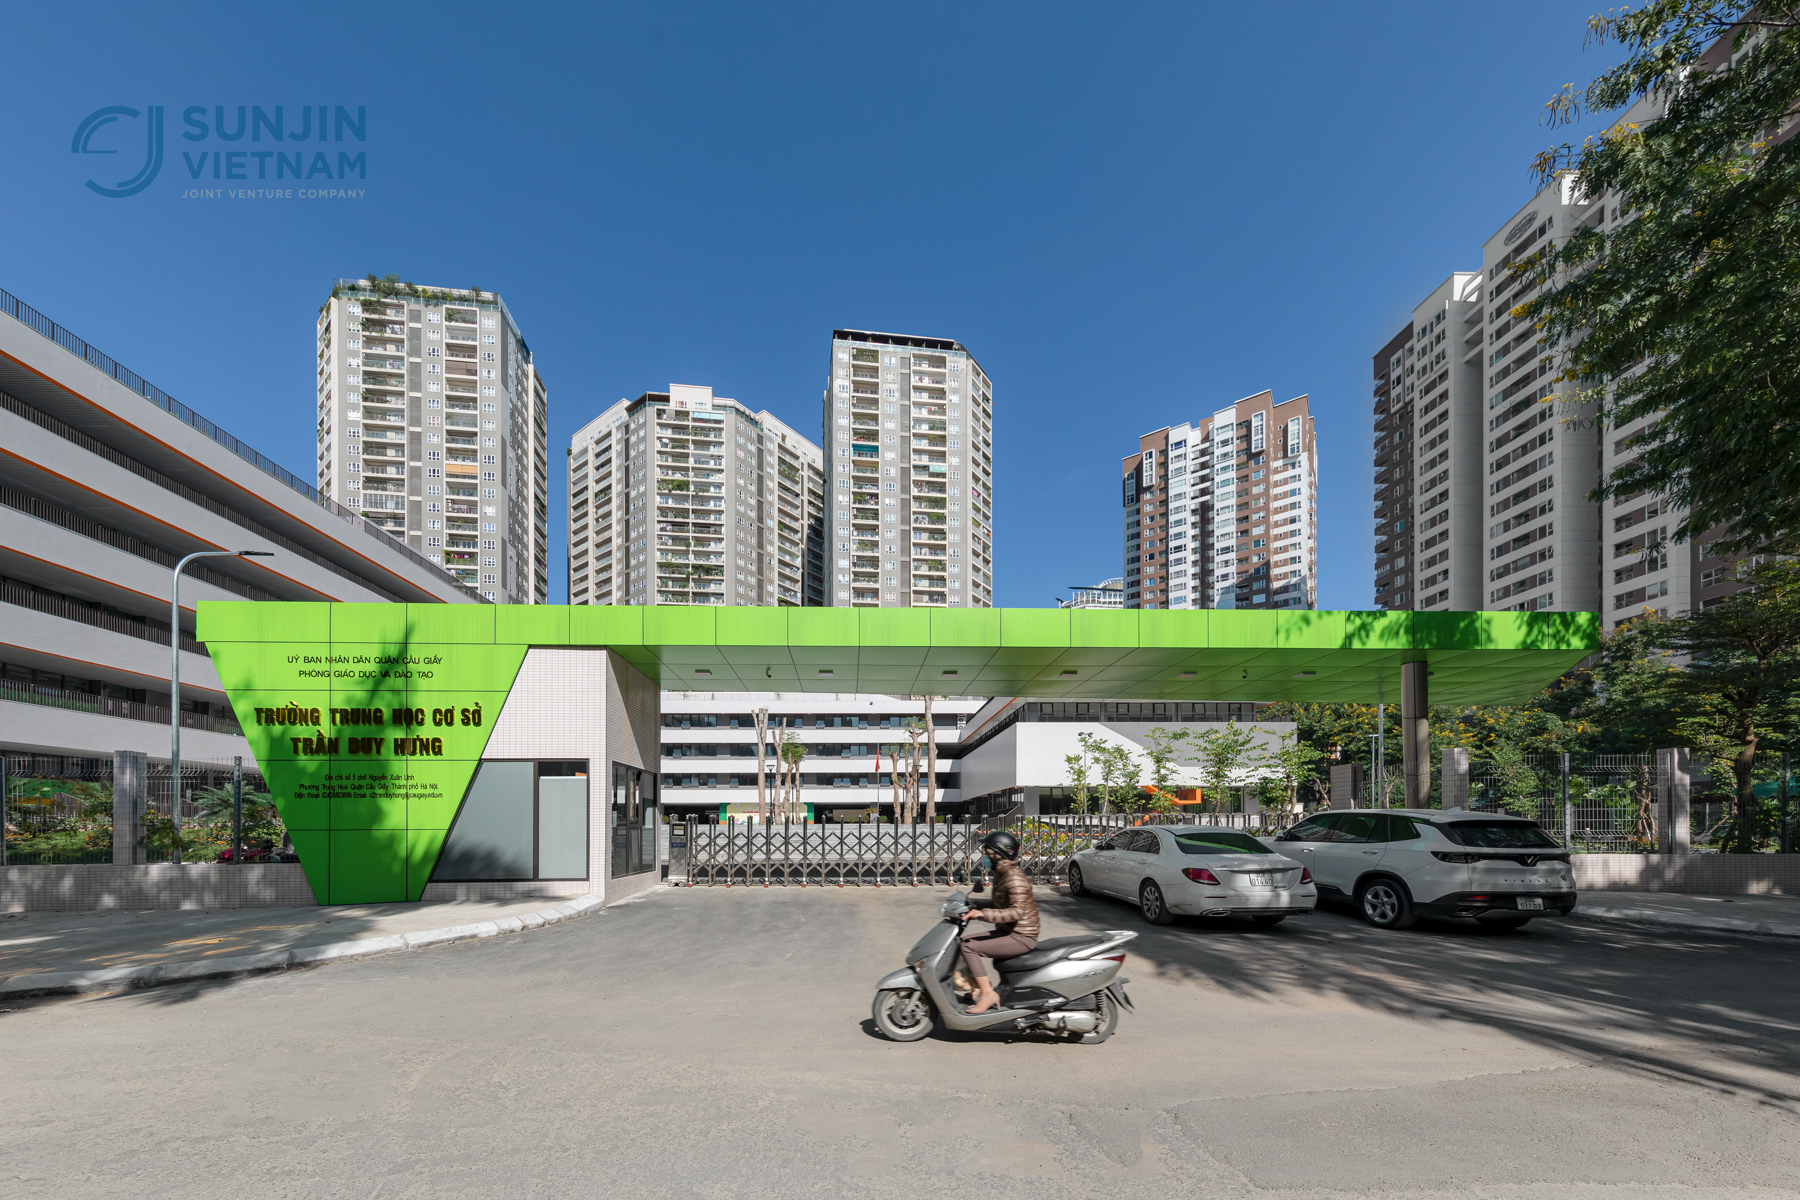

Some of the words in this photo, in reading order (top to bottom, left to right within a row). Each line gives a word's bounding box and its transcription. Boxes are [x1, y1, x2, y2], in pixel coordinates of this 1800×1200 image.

[325, 654, 349, 664] NHÂN
[353, 655, 370, 664] DÂN
[374, 655, 398, 666] QUẬN
[402, 654, 420, 664] CẦU
[424, 654, 442, 664] GIẤY
[299, 669, 330, 678] PHÒNG
[334, 669, 355, 678] GIÁO
[359, 671, 376, 679] DỤC
[380, 669, 390, 678] VÀ
[394, 669, 412, 678] ĐÀO
[417, 671, 434, 680] TẠO
[254, 700, 322, 726] TRƯỜNG
[329, 708, 384, 726] TRUNG
[392, 708, 426, 730] HỌC
[433, 705, 456, 726] CƠ
[461, 702, 483, 726] SỞ
[290, 729, 340, 756] TRẦN
[348, 737, 385, 756] DUY
[394, 735, 443, 756] HƯNG
